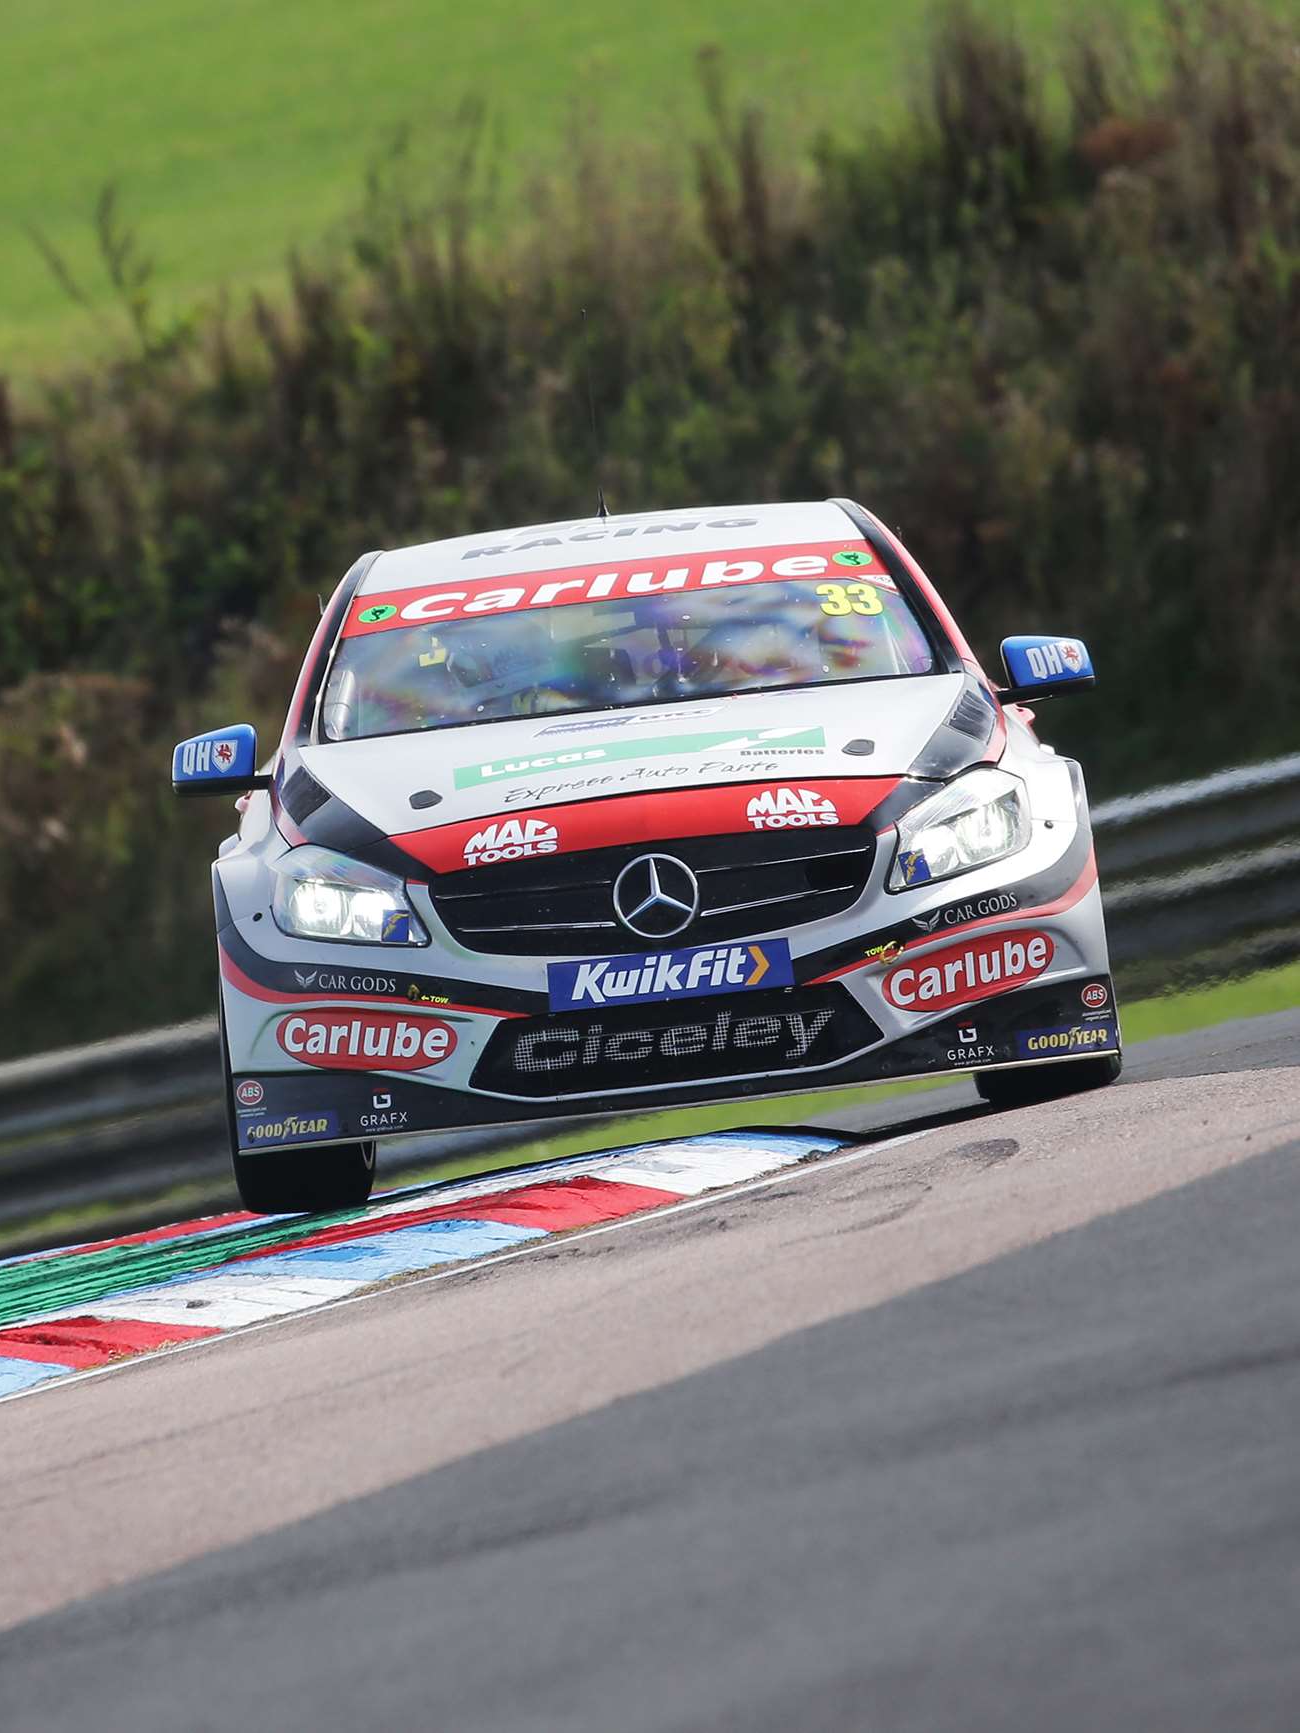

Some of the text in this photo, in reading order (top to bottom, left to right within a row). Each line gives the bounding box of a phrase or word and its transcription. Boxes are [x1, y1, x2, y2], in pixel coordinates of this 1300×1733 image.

[461, 518, 758, 560] RACING
[399, 555, 829, 620] Carlube
[815, 583, 884, 616] 33
[1025, 644, 1063, 679] QH
[182, 741, 212, 776] QH
[479, 749, 607, 777] Lucas
[504, 761, 779, 803] Express Auto Parts
[746, 787, 837, 817] MAC
[747, 812, 840, 829] TOOLS
[463, 819, 558, 854] MAC
[463, 840, 558, 866] TOOLS
[944, 892, 1018, 925] CAR GODS
[864, 944, 885, 957] TOW
[318, 974, 396, 992] CAR GODS
[888, 936, 1047, 1006] Carlube
[429, 995, 449, 1004] TOW
[1085, 988, 1105, 1001] ABS
[283, 1017, 449, 1059] Carlube
[512, 1008, 836, 1073] Ciceley
[946, 1045, 995, 1061] GRAFX
[1027, 1026, 1108, 1050] GOODYEAR
[241, 1087, 261, 1099] ABS
[360, 1111, 408, 1127] GRAFX
